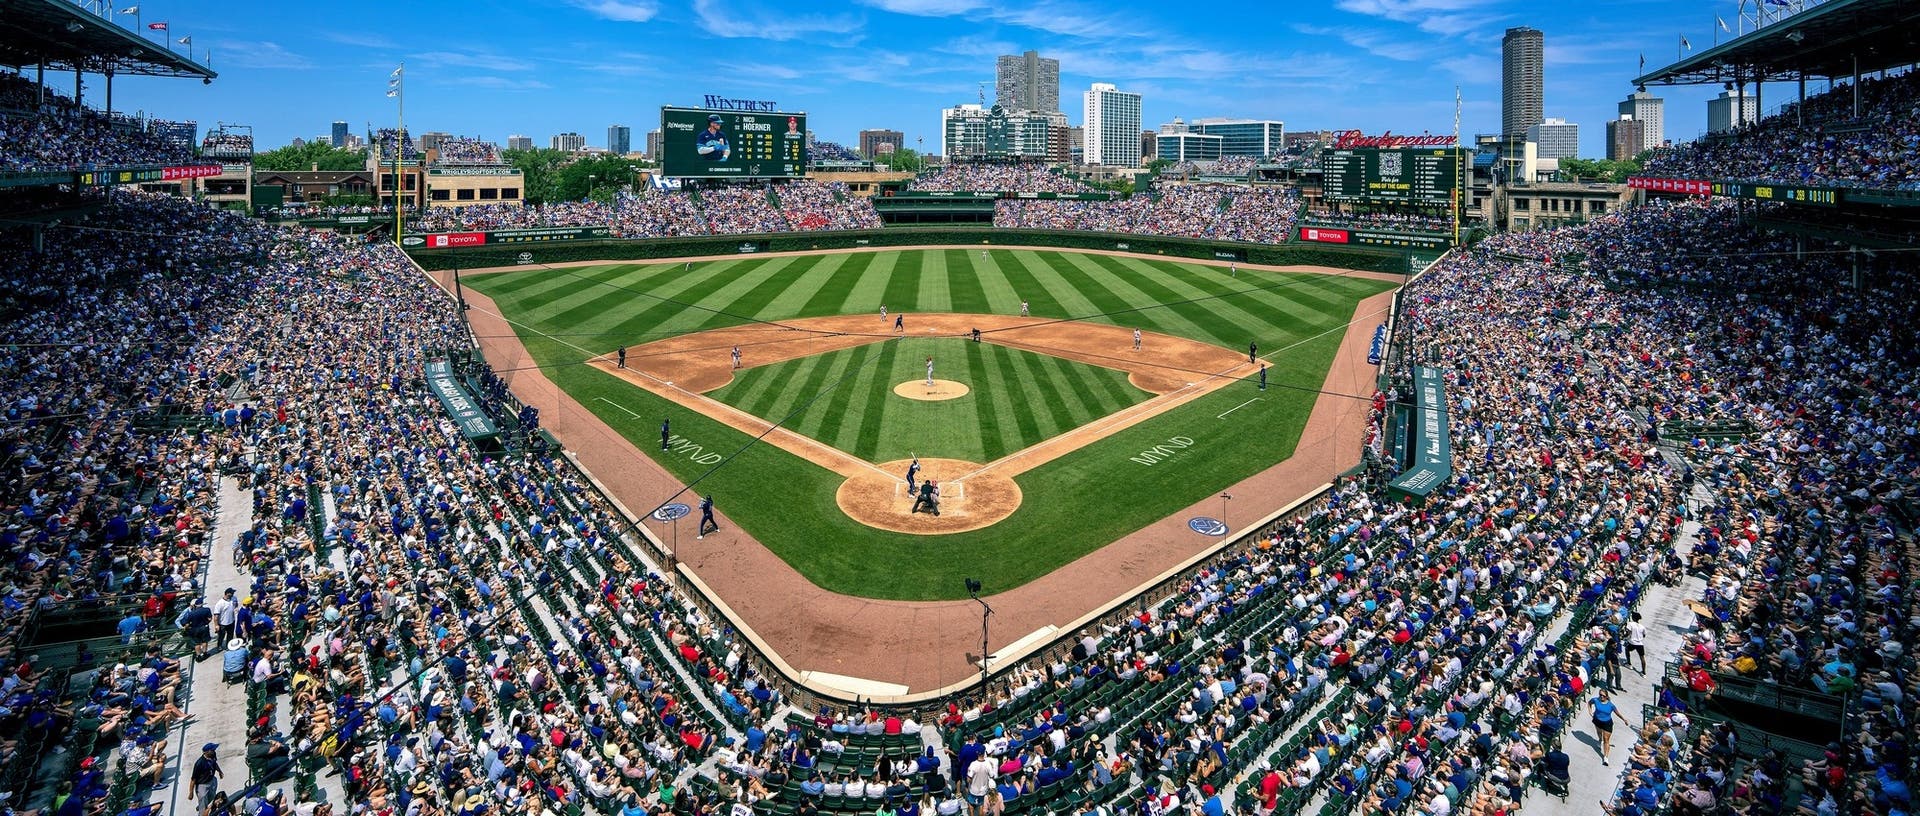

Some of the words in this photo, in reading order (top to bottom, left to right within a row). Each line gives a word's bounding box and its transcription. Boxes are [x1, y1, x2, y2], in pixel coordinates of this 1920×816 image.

[704, 95, 776, 112] WINTRUST
[743, 123, 771, 131] HOERNER
[1332, 129, 1457, 149] Budweiser
[435, 378, 461, 397] CHICAGO
[448, 396, 472, 411] CUBS
[658, 434, 722, 465] MYND
[1130, 436, 1195, 466] MYND
